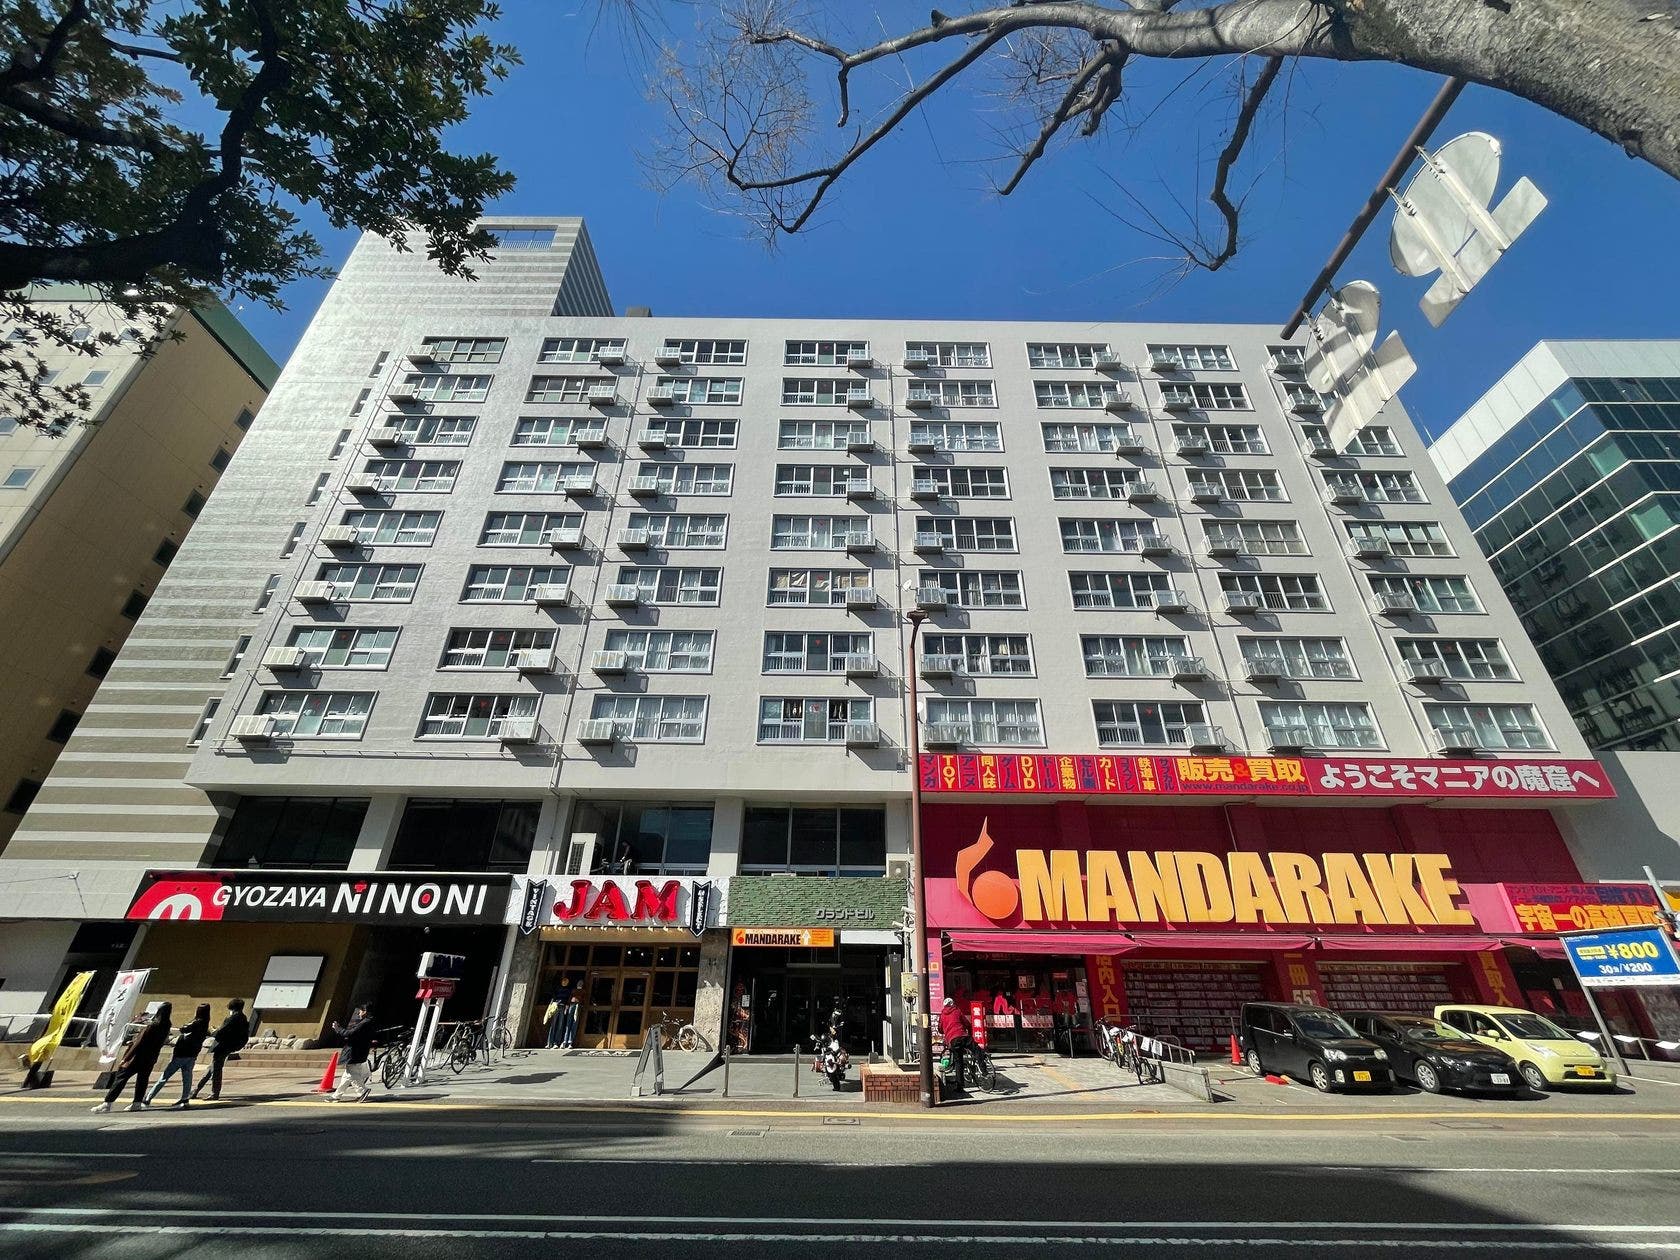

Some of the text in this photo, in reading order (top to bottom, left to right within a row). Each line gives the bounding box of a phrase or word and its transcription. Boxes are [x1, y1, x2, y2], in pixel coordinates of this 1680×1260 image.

[943, 755, 956, 789] TOY
[961, 756, 976, 787] アニメ
[981, 756, 997, 788] 同人誌
[1002, 756, 1016, 788] ゲーム
[1020, 756, 1036, 789] DVD
[1099, 757, 1116, 790] カード
[1320, 763, 1600, 792] ようこそマニアの魔窟へ
[212, 882, 488, 915] GYOZAYA NINONI
[552, 879, 681, 921] JAM
[1016, 849, 1475, 925] MANDARAKE
[525, 888, 540, 928] VINTAGE
[744, 934, 801, 945] MANDARAKE
[1606, 941, 1659, 959] ¥800
[973, 1007, 984, 1039] 営業中
